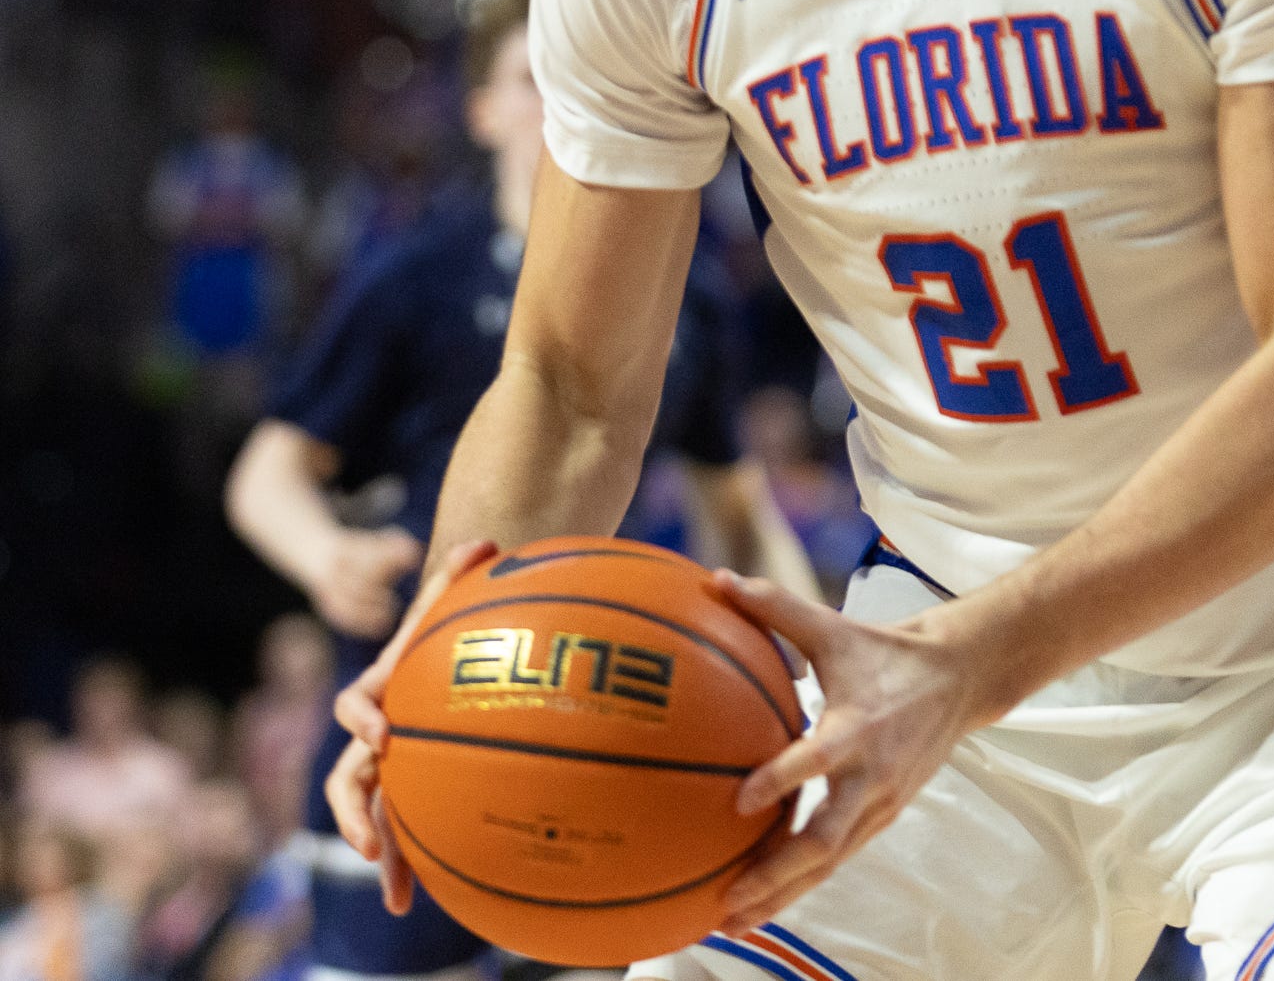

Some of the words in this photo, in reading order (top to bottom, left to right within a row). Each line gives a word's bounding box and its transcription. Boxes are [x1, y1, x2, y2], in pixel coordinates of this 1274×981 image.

[748, 12, 1165, 186] FLORIDA
[878, 210, 1141, 421] 21
[452, 628, 675, 708] ELITE
